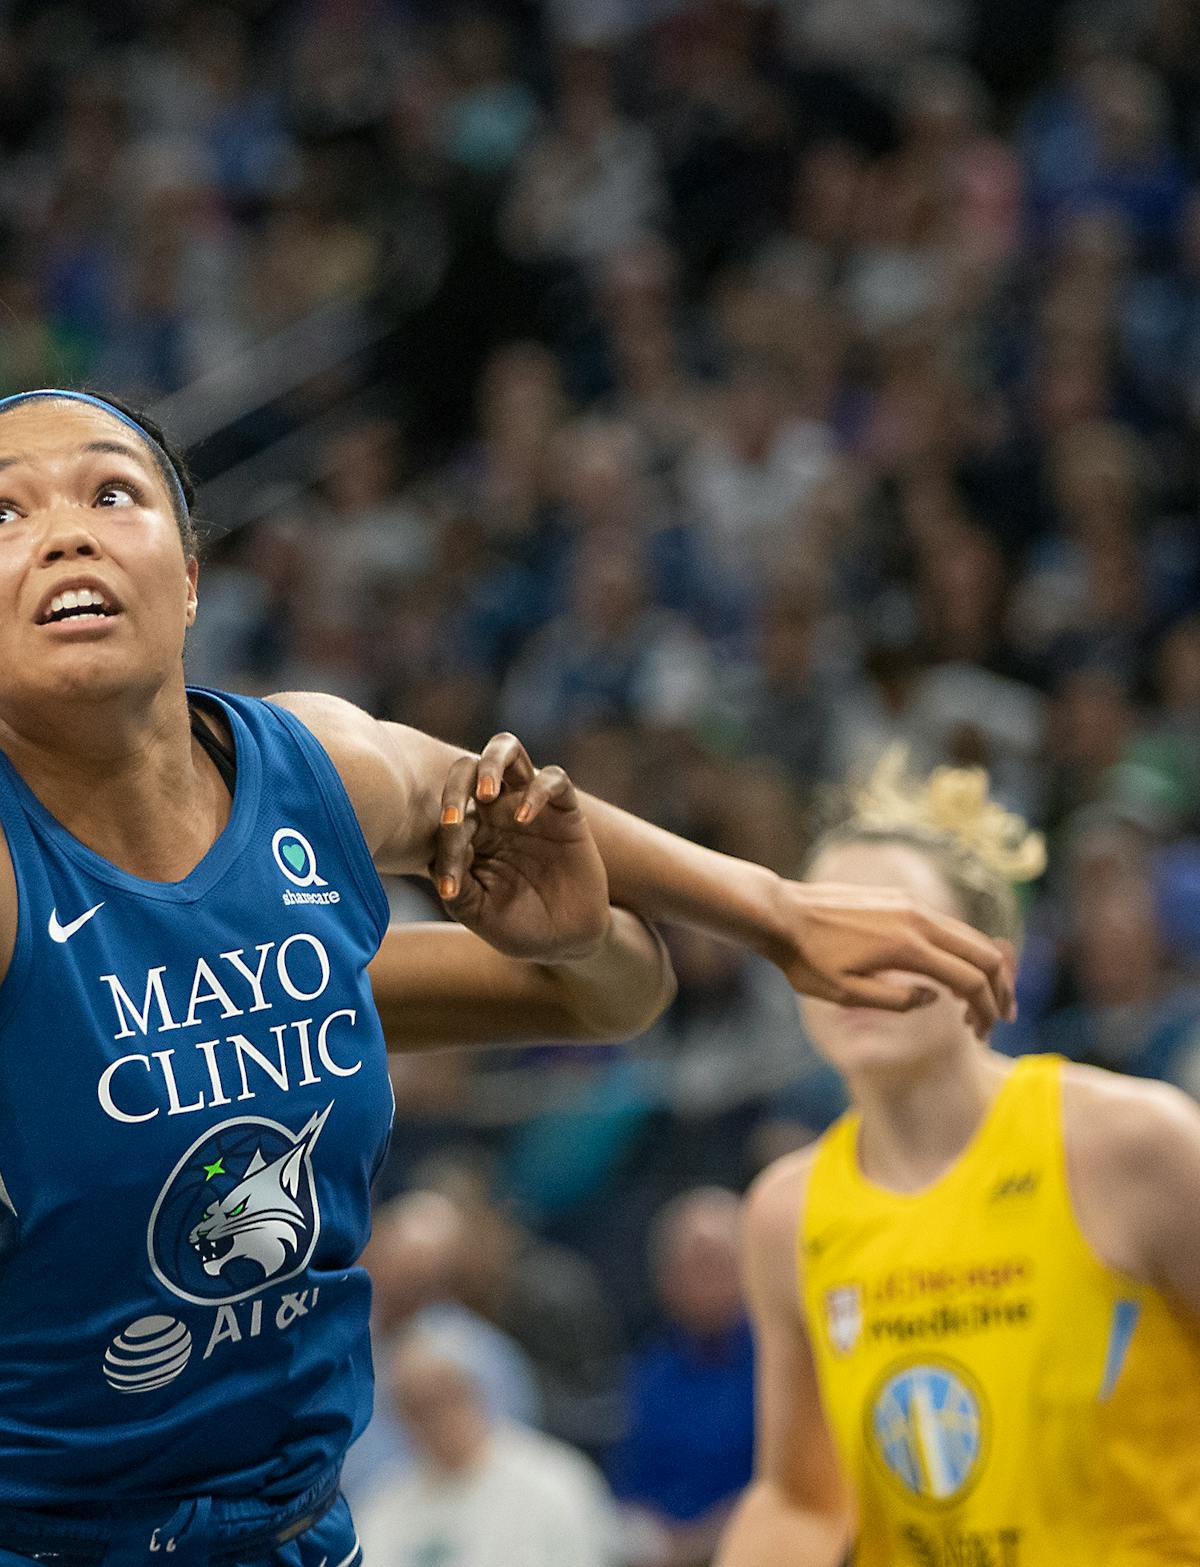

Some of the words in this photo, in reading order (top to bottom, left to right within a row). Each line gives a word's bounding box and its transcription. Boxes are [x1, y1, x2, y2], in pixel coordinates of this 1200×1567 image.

[282, 889, 340, 906] sharecare
[100, 933, 331, 1040] MAYO
[97, 1009, 362, 1123] CLINIC
